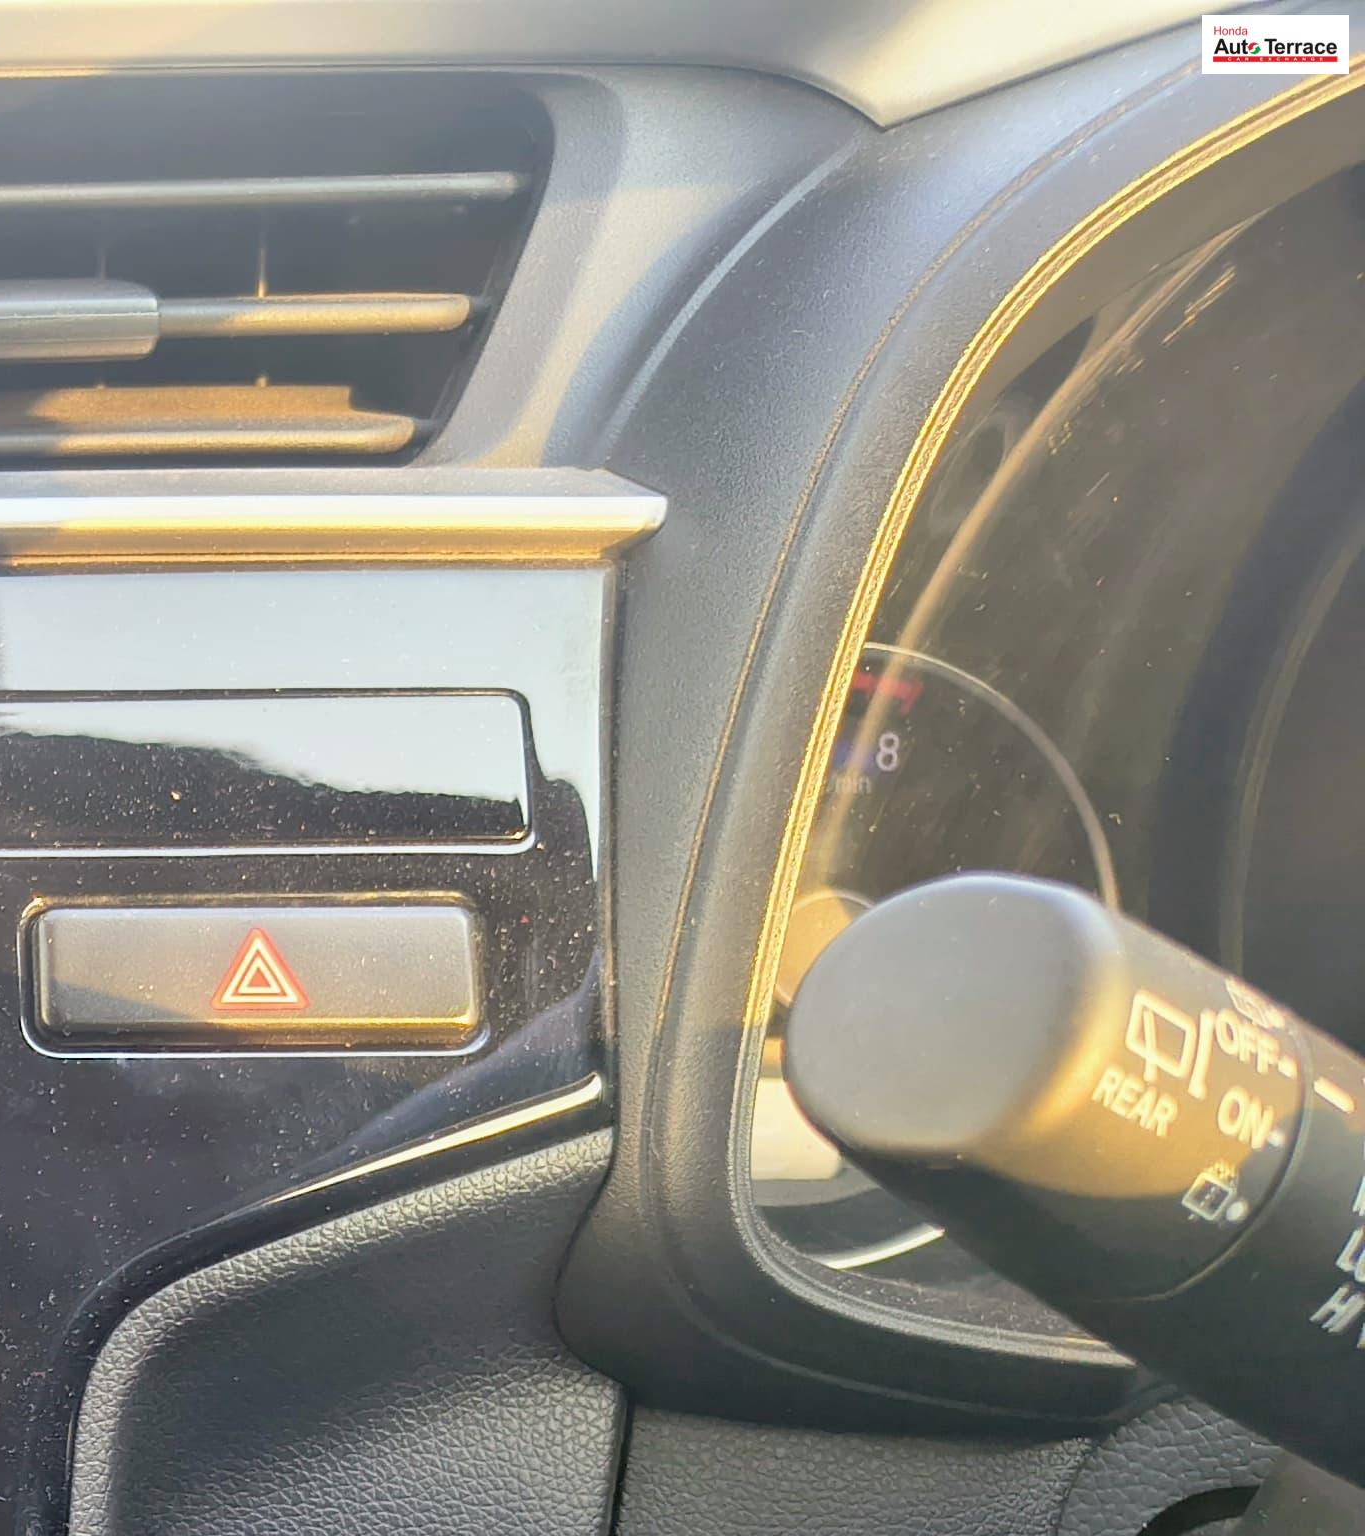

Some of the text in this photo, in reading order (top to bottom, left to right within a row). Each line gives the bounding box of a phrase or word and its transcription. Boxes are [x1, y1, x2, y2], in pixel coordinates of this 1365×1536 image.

[1215, 1008, 1280, 1074] OFF
[1092, 1063, 1178, 1137] REAR
[1218, 1084, 1275, 1150] ON
